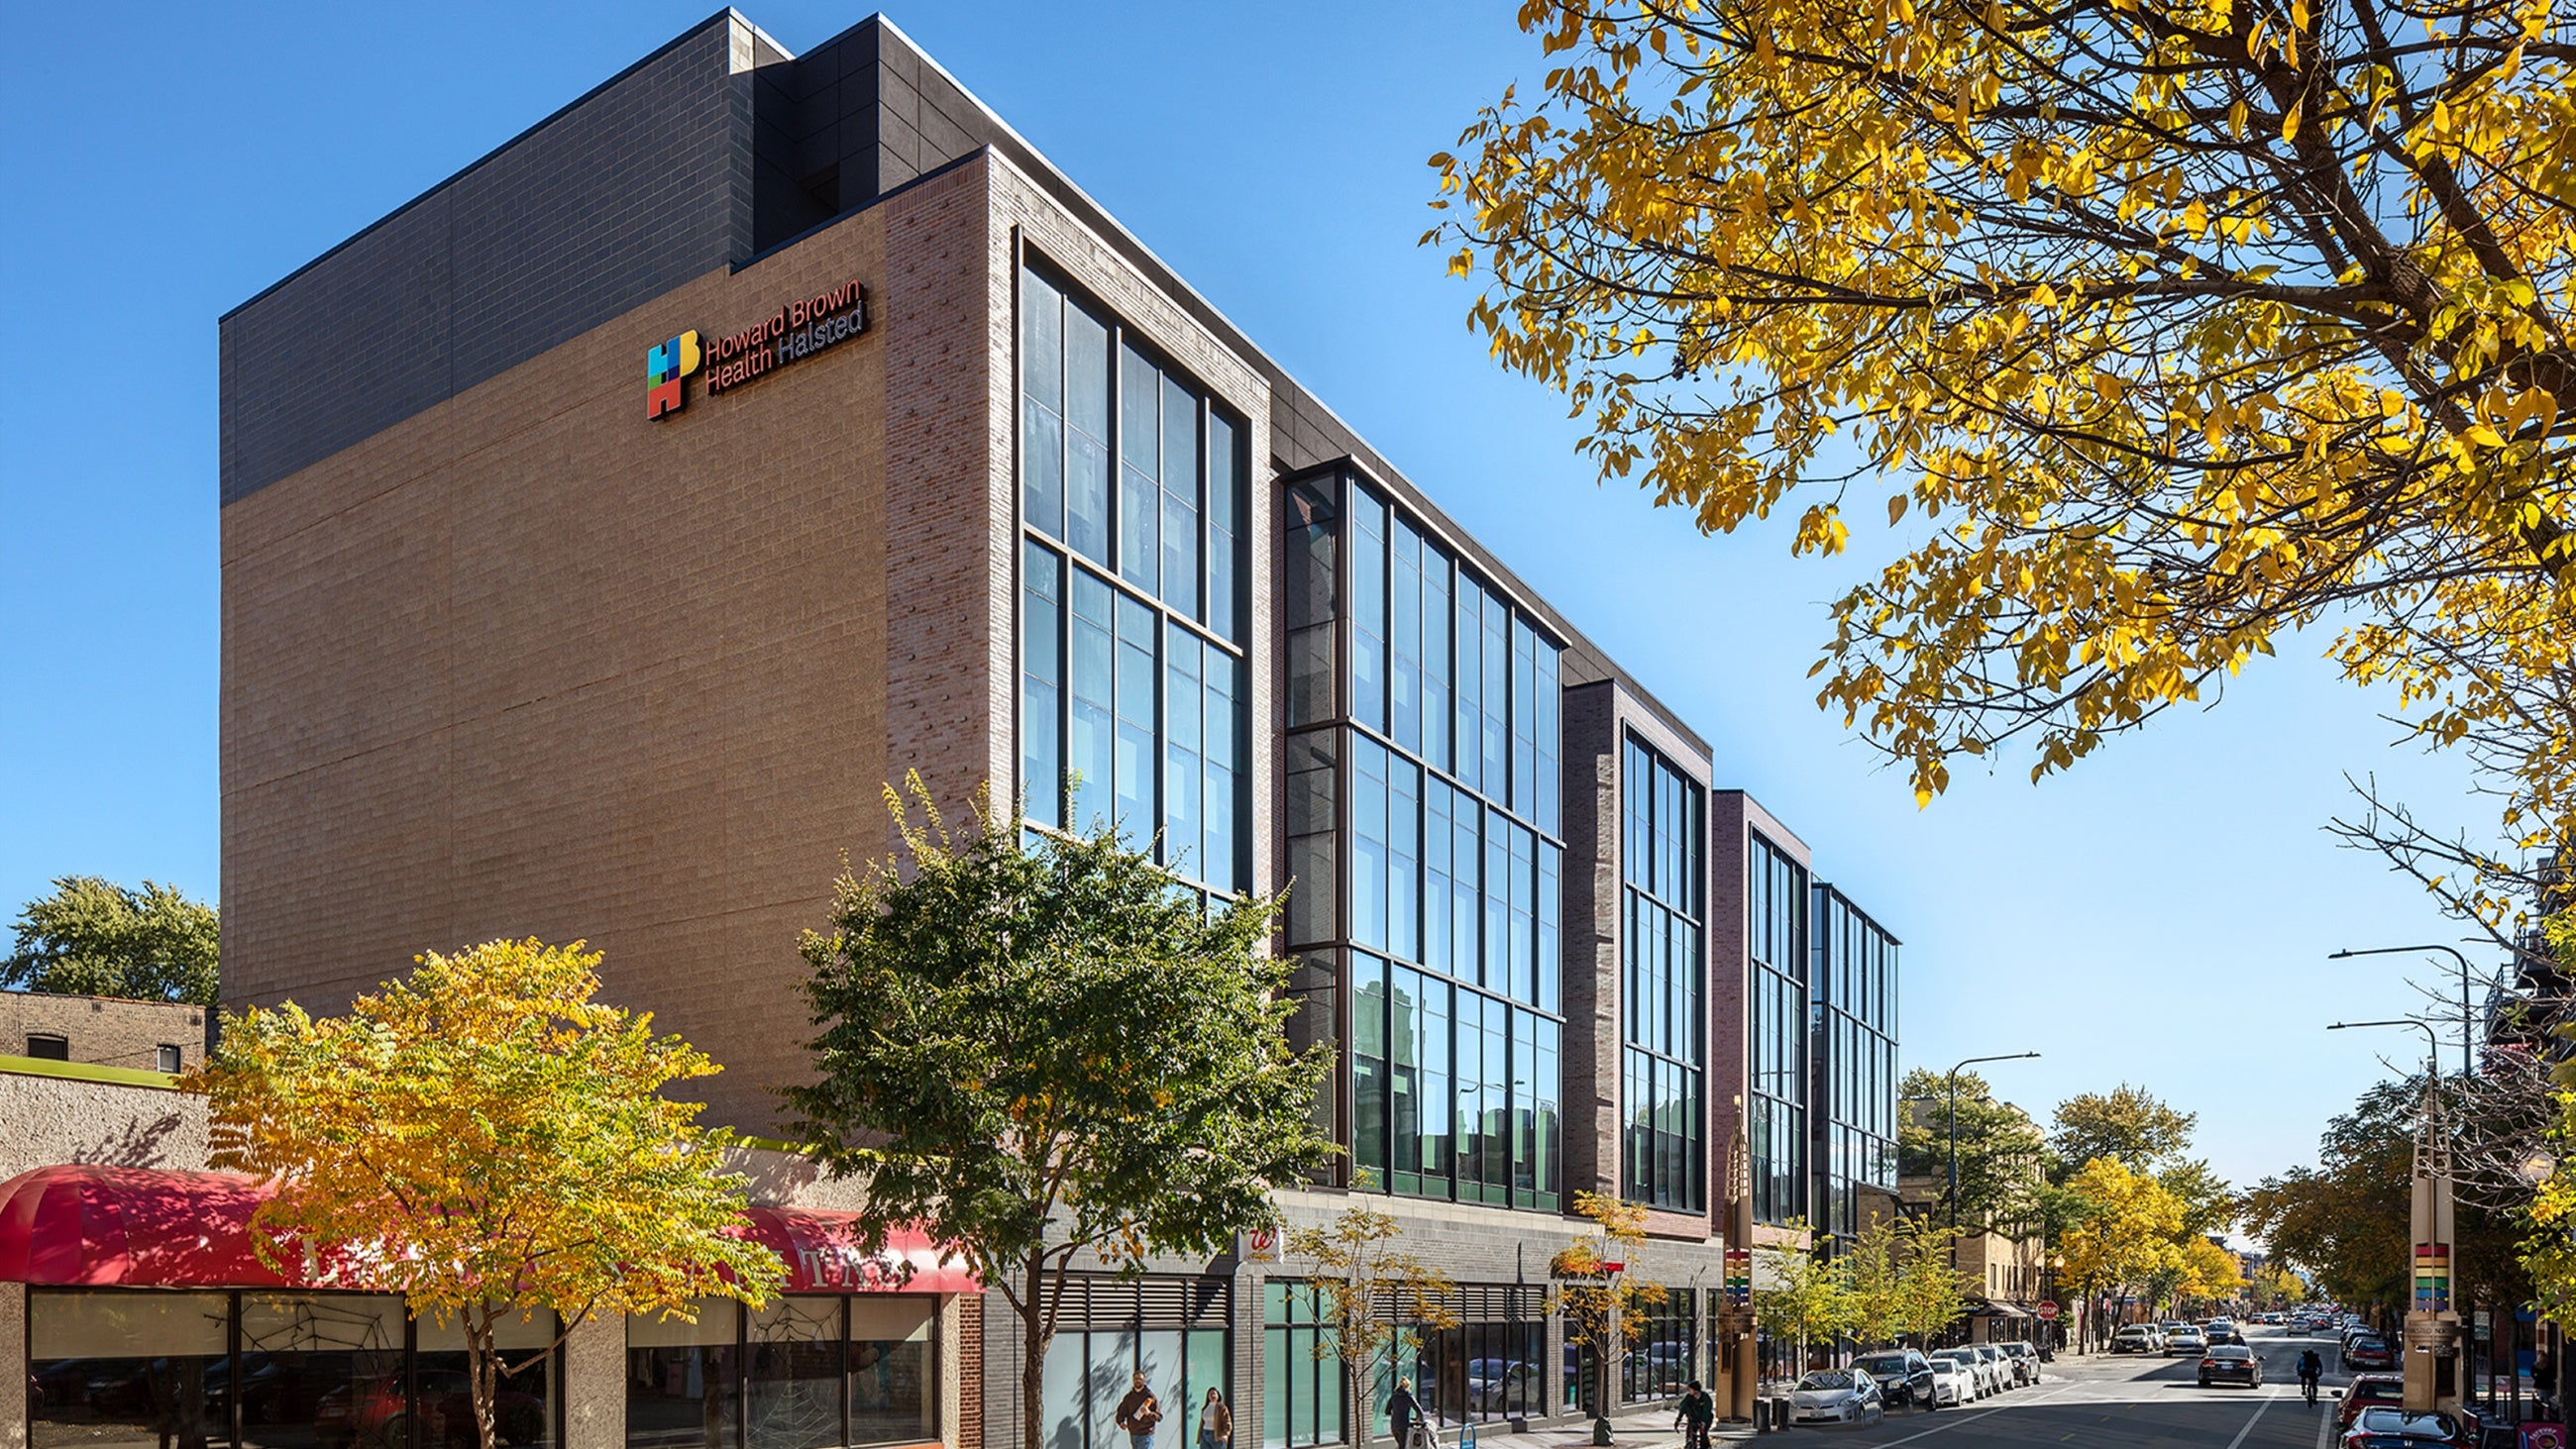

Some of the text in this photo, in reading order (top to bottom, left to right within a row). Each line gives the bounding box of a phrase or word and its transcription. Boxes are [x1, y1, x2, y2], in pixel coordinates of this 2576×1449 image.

[705, 279, 861, 366] Howard Brown
[705, 300, 863, 395] Health Halsted
